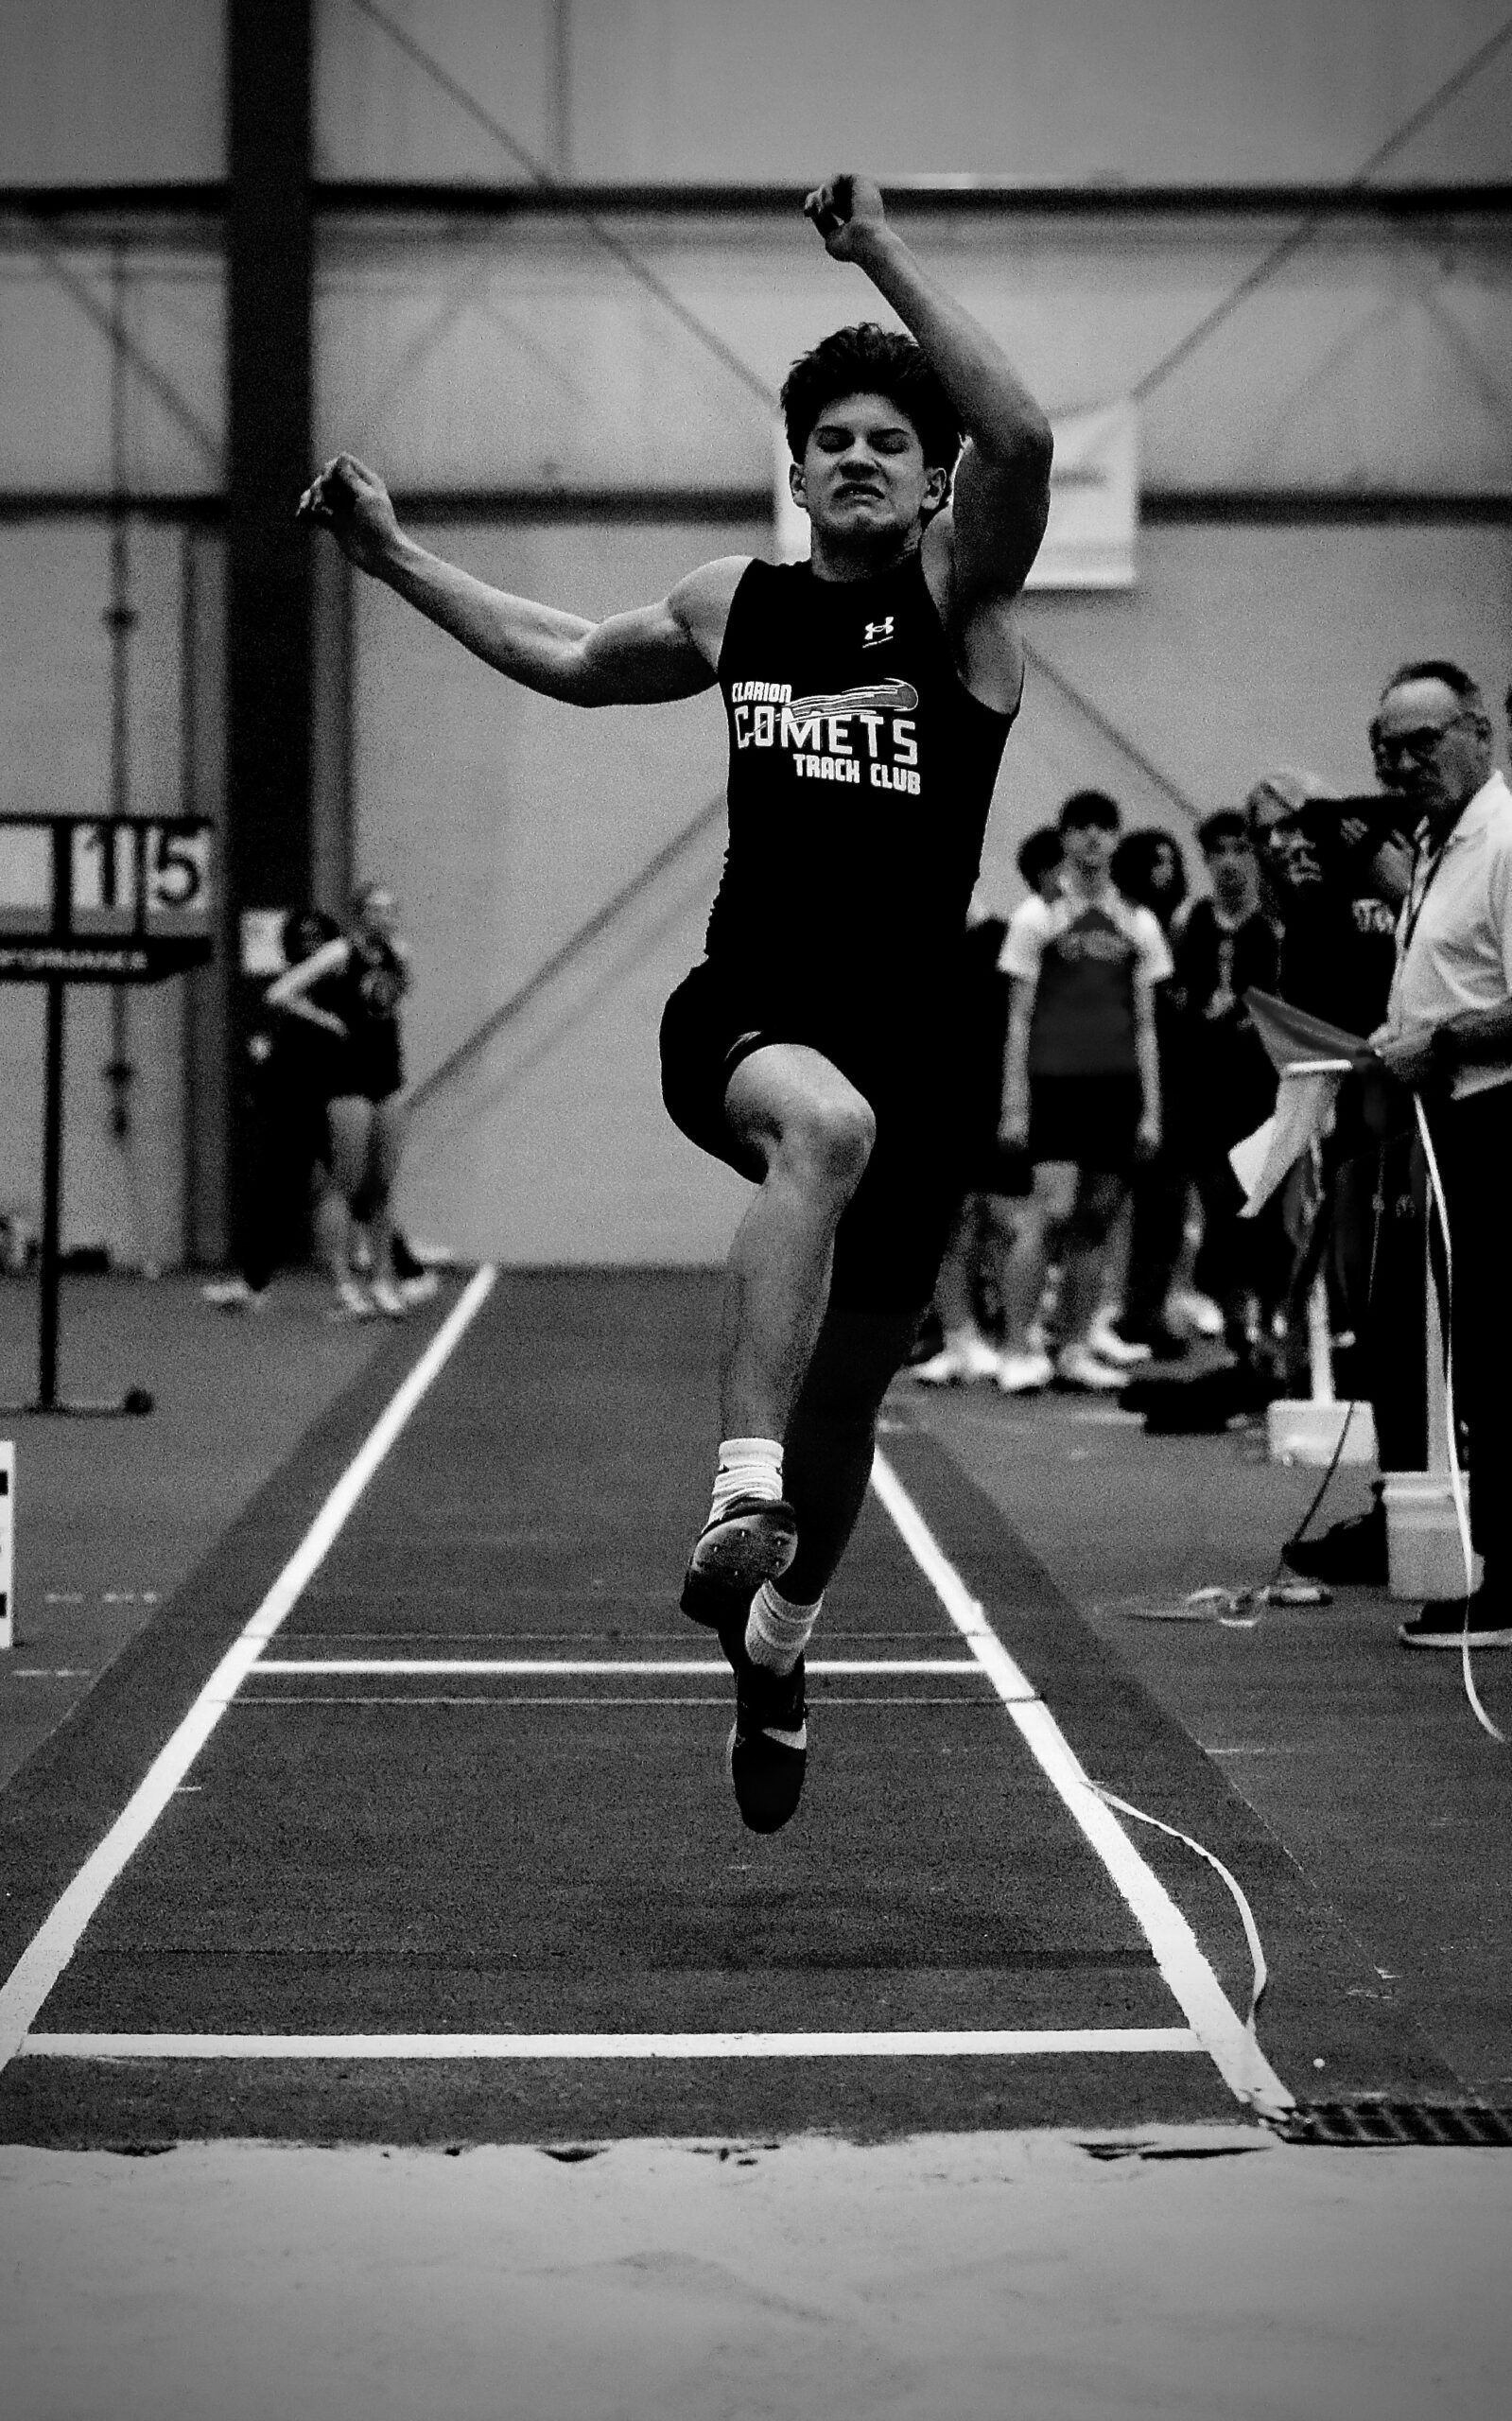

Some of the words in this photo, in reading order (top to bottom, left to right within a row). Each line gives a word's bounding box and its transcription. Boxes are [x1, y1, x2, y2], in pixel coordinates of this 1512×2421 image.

[732, 681, 792, 704] CLARION
[735, 705, 918, 765] COMETS
[792, 754, 860, 783] TRACK
[870, 763, 921, 794] CLUB
